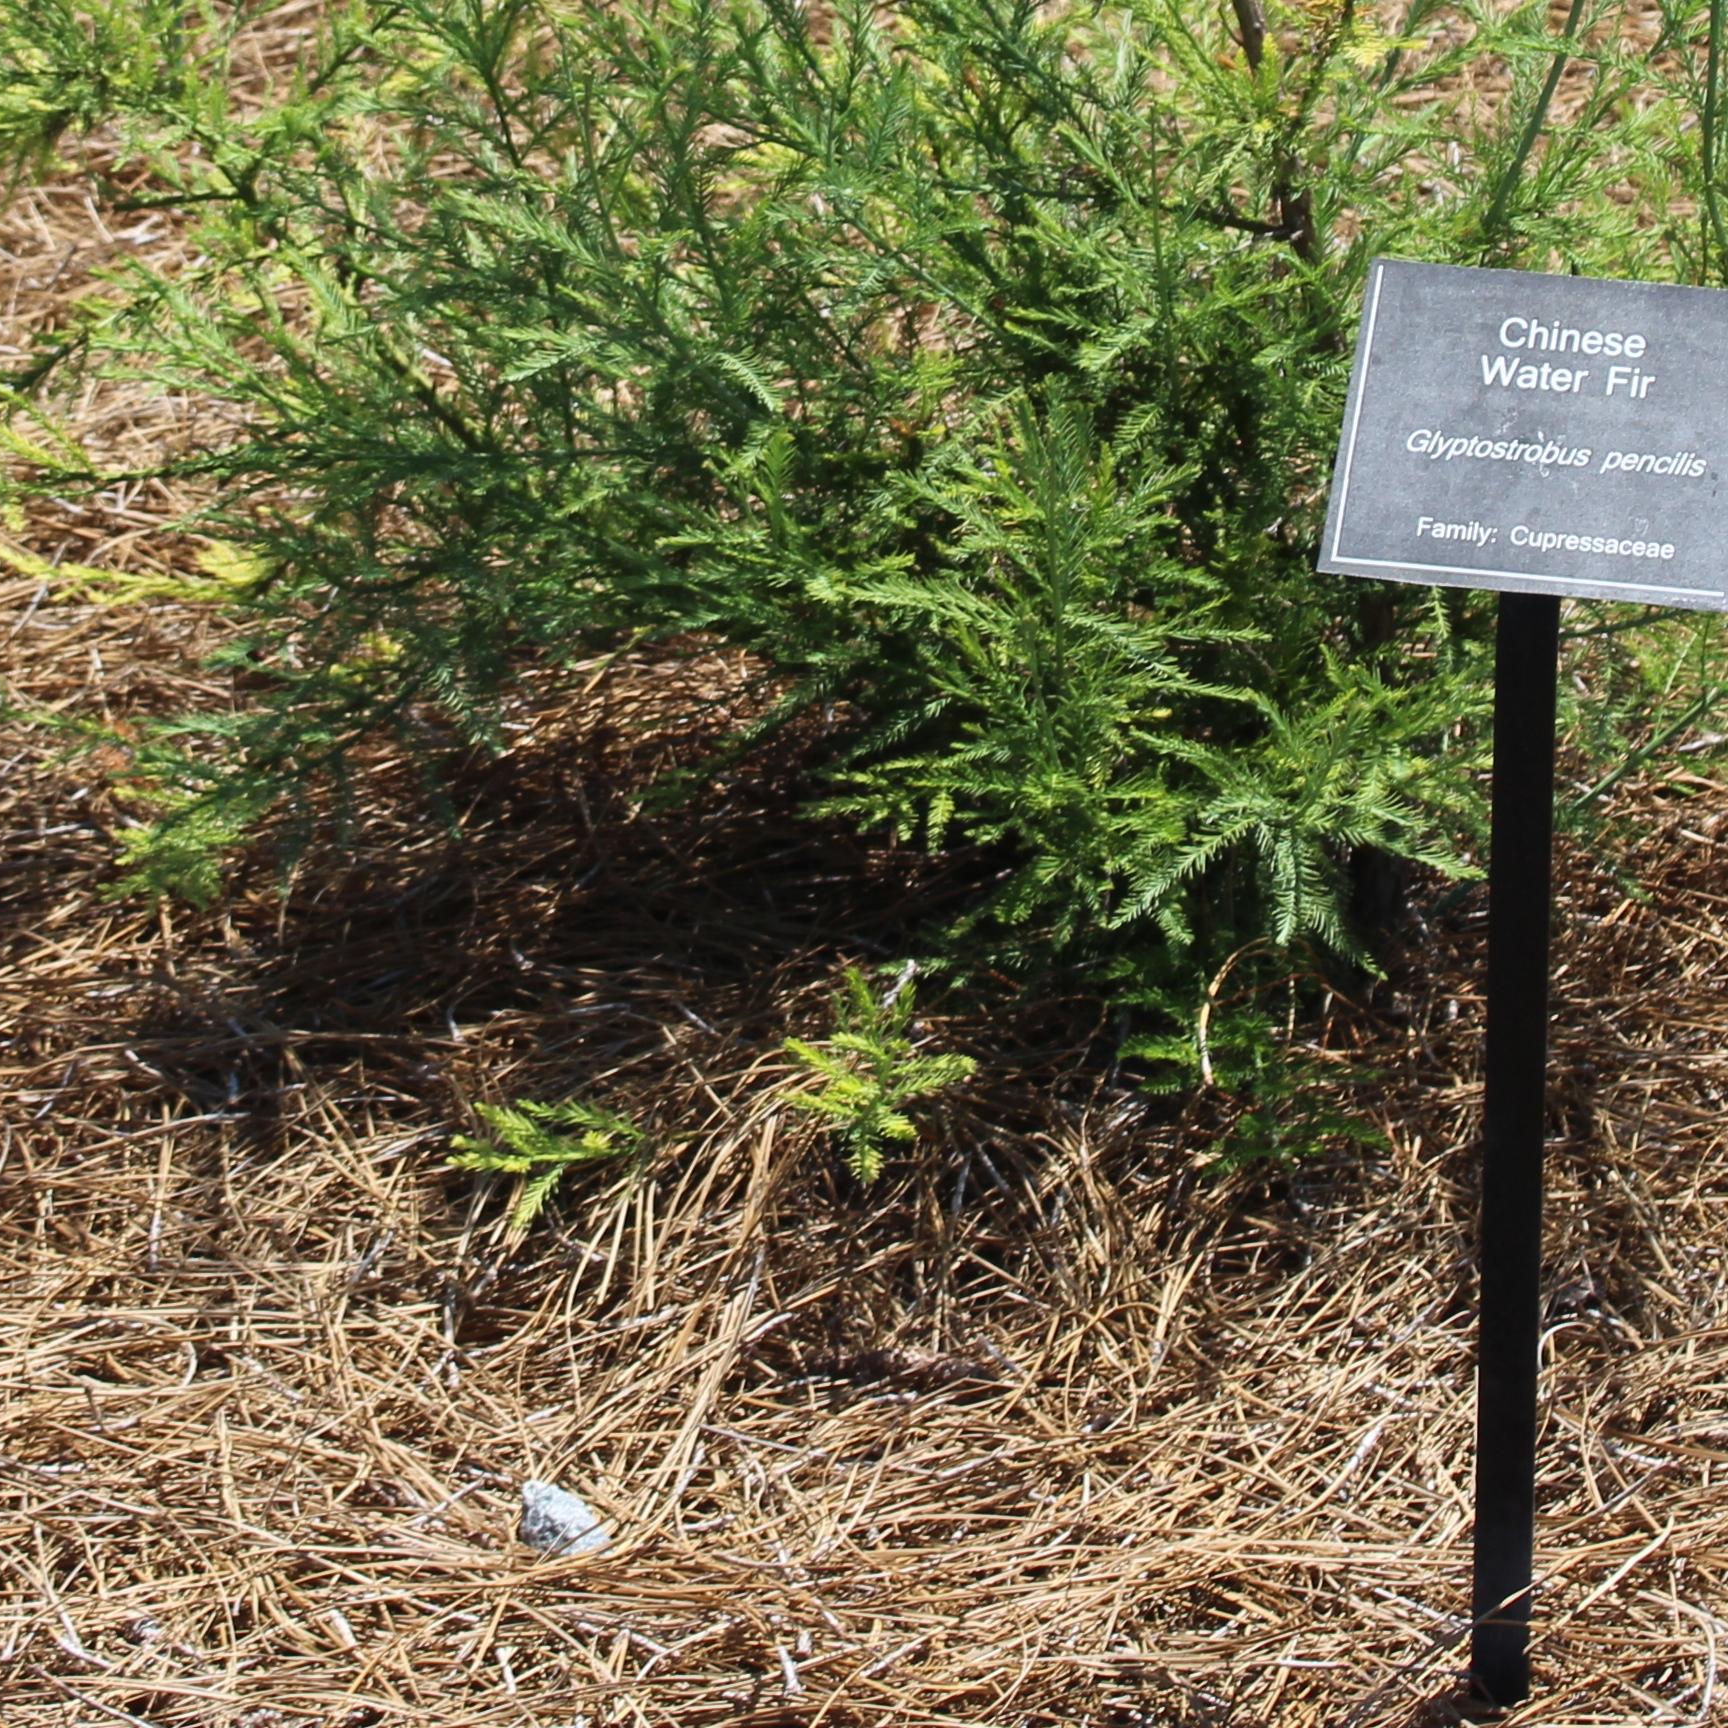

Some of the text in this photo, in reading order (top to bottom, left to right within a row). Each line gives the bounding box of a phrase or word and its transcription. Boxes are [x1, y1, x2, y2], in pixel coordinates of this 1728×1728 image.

[1499, 317, 1646, 358] Chinese
[1481, 355, 1656, 399] Water Fir
[1406, 429, 1707, 477] Glyptostrobus pencilis
[1416, 516, 1675, 560] Family: Cupressaceae
